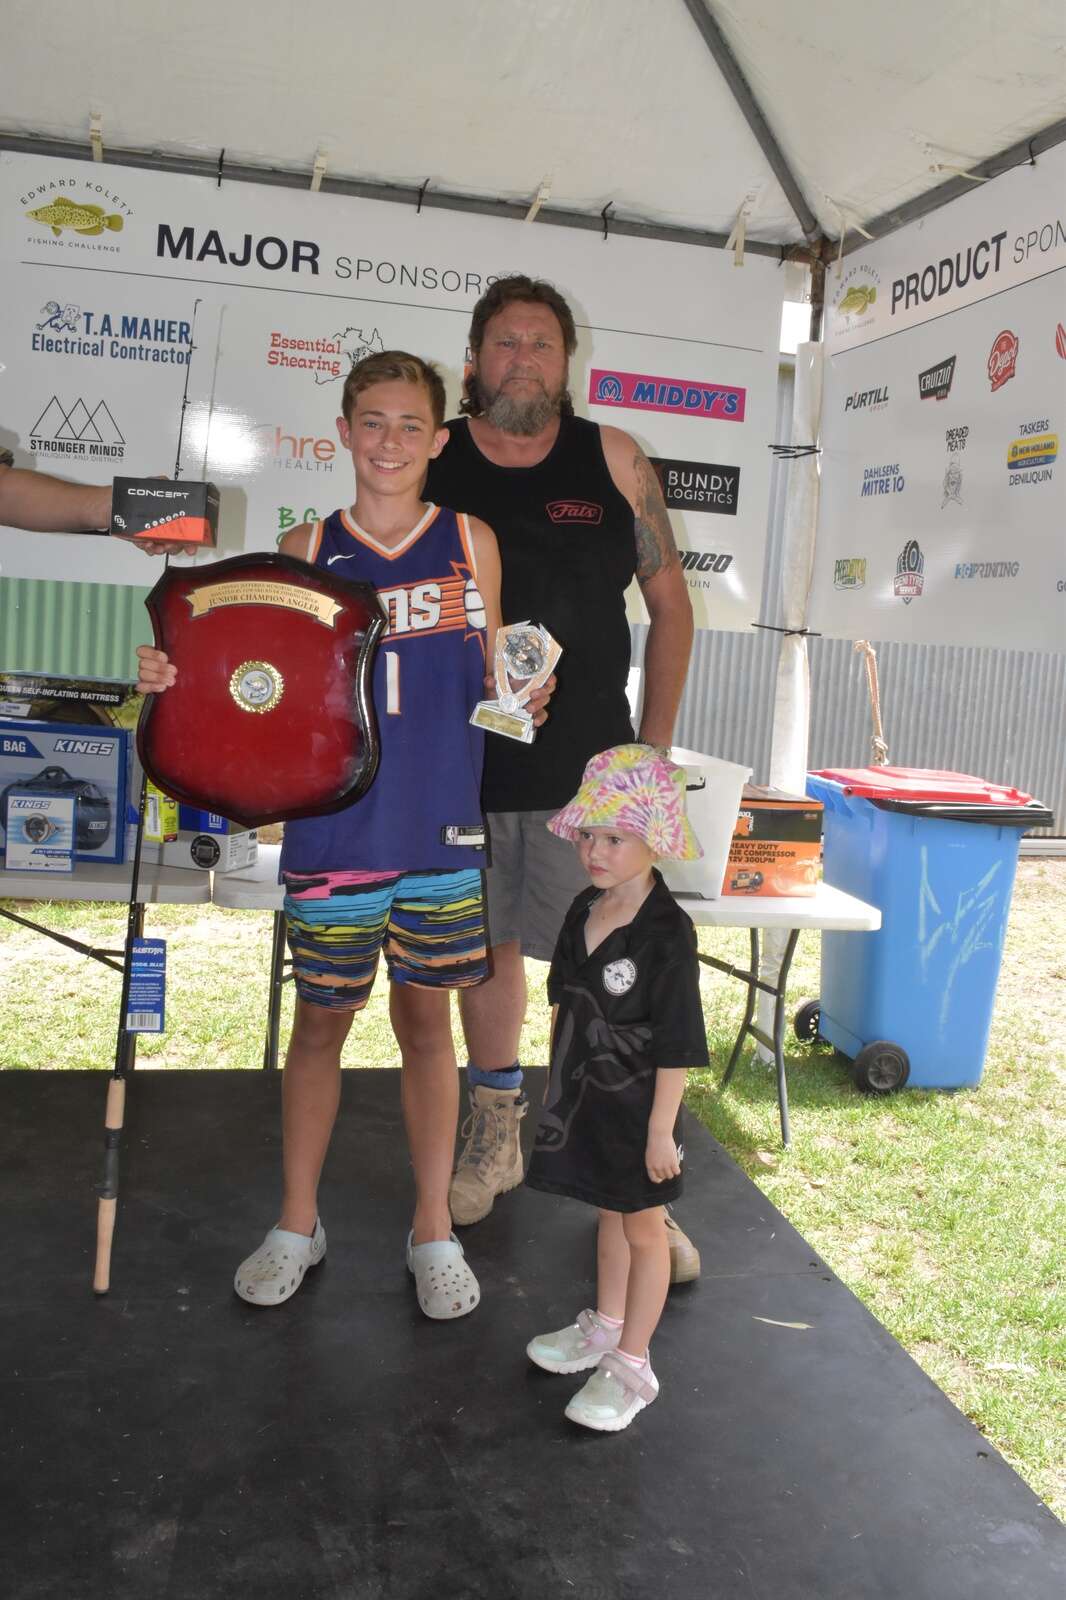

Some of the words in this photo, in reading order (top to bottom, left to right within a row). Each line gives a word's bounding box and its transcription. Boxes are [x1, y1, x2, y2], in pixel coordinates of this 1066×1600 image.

[20, 178, 76, 205] EDWARD
[86, 180, 135, 216] KOLETY
[27, 237, 64, 247] FISHING
[68, 241, 121, 253] CHALLENGE
[156, 223, 320, 275] MAJOR
[891, 230, 1007, 315] PRODUCT
[31, 333, 104, 357] Electrical
[110, 341, 192, 365] Contractor
[270, 332, 341, 354] Essential
[267, 350, 341, 376] Shearing
[632, 381, 739, 414] MIDDY'S
[844, 385, 889, 412] PURTILL
[1019, 419, 1049, 436] TASKERS
[30, 439, 85, 454] STRONGER
[89, 444, 125, 457] MINDS
[274, 426, 336, 461] hre
[273, 457, 334, 473] HEALTH
[863, 463, 900, 480] DAHLSENS
[668, 470, 735, 492] BUNDY
[1008, 469, 1053, 486] DENILIQUIN
[127, 488, 190, 500] CONCEPT
[667, 487, 733, 505] LOGISTICS
[861, 477, 891, 497] MITRE
[209, 595, 239, 607] JUNIOR
[240, 594, 285, 603] CHAMPION
[287, 598, 320, 613] ANGLER
[385, 651, 401, 715] 1
[22, 687, 79, 699] SELF-INFLATING
[80, 692, 120, 703] MATTRESS
[4, 740, 26, 753] BAG
[54, 739, 115, 757] KINGS
[10, 799, 51, 810] KINGS
[731, 842, 756, 850] HEAVY
[757, 843, 779, 851] DUTY
[743, 850, 796, 858] COMPRESSOR
[728, 855, 743, 863] 12V
[744, 856, 776, 864] 300LPM
